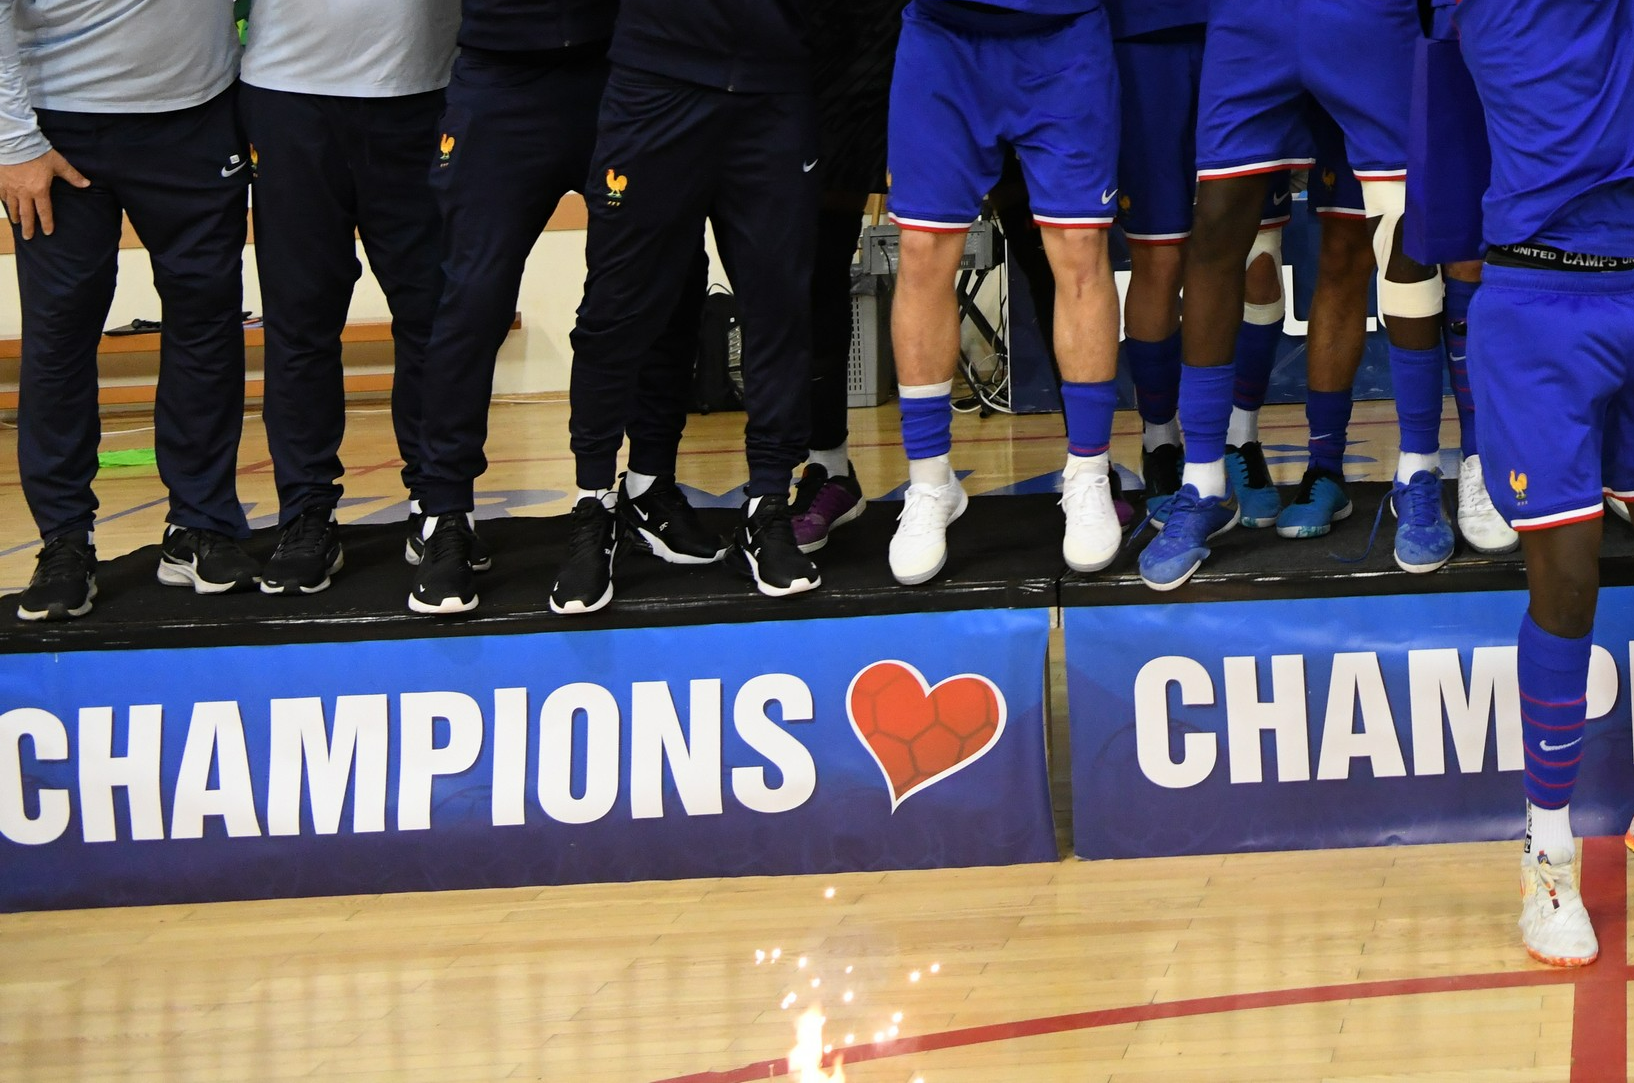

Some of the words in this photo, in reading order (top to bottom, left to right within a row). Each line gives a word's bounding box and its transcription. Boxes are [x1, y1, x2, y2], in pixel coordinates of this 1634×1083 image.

[1513, 246, 1557, 260] UNITED
[1562, 251, 1618, 267] CAMPS
[0, 673, 815, 846] CHAMPIONS
